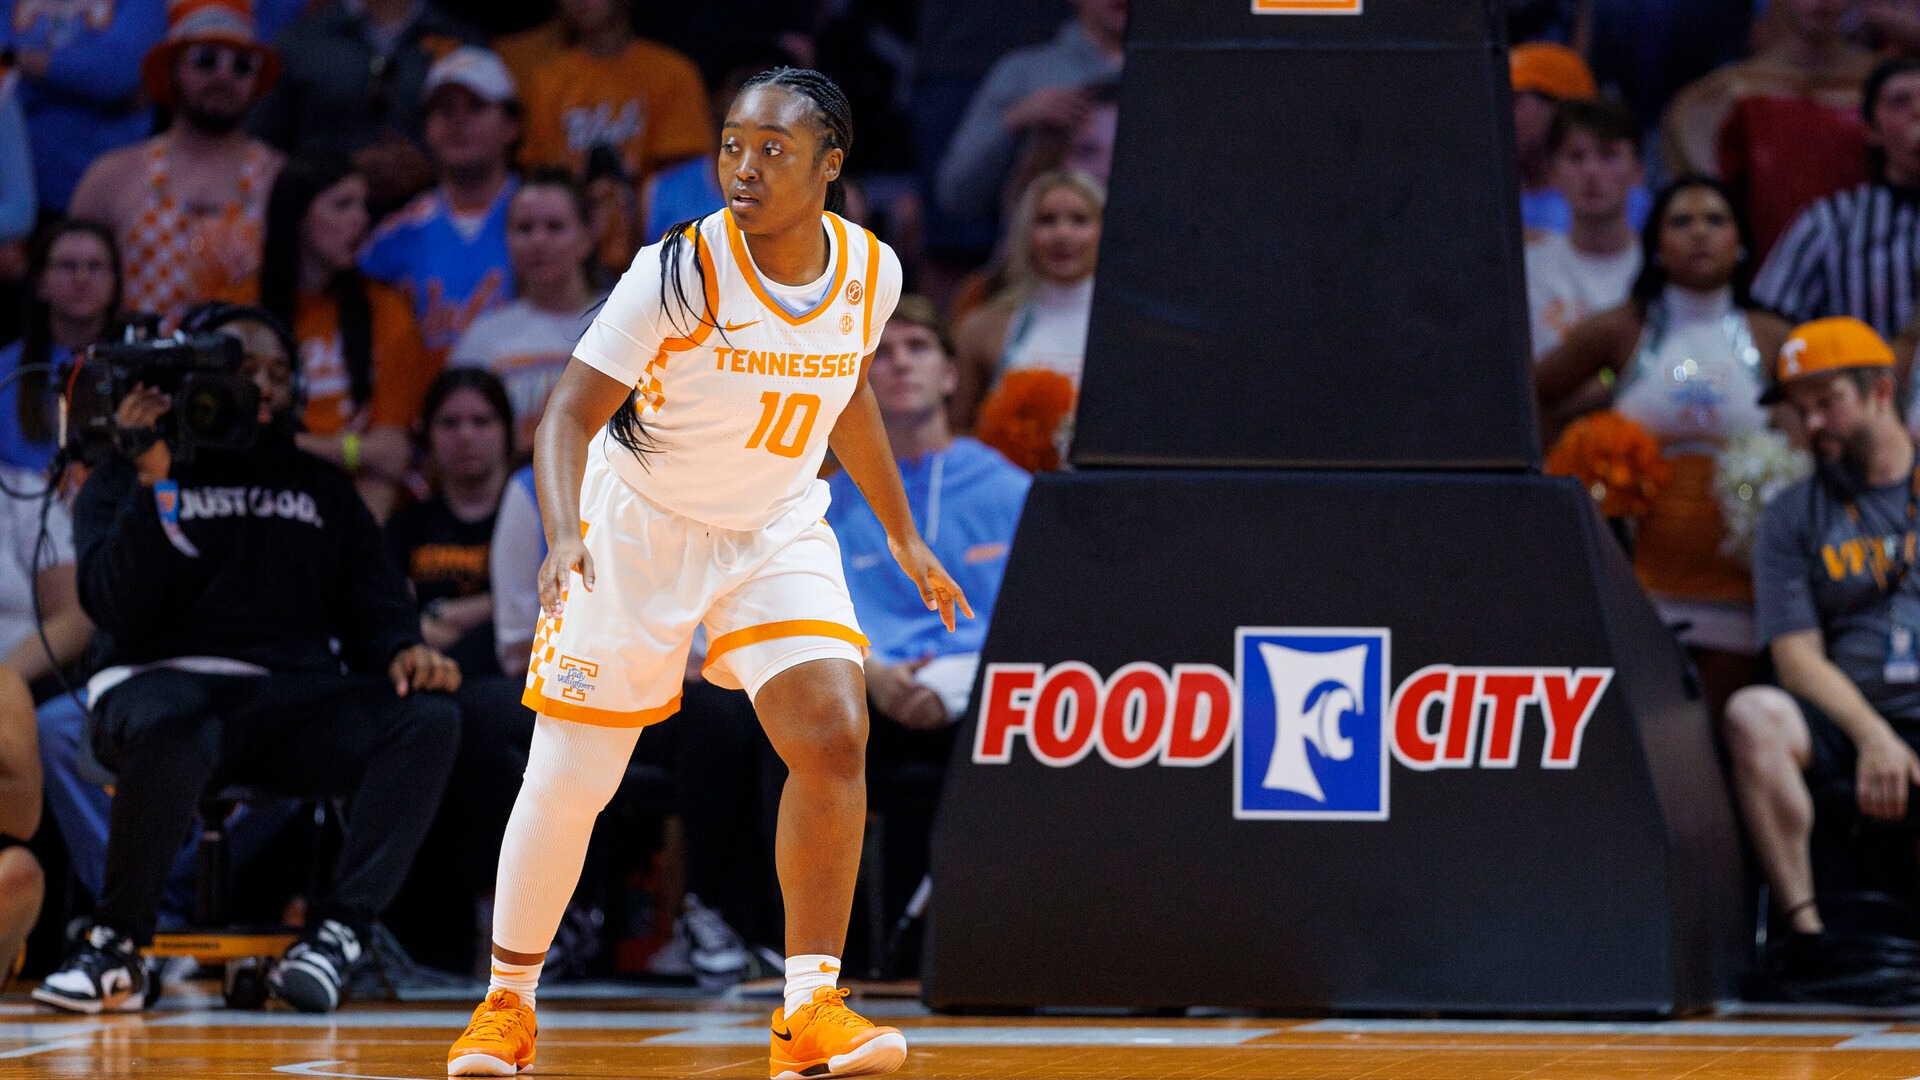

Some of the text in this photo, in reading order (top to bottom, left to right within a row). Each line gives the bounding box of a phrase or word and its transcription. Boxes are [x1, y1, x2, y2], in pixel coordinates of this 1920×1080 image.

[713, 346, 858, 379] TENNESSEE
[744, 390, 822, 459] 10
[972, 661, 1238, 768] FOOD
[1389, 664, 1614, 771] CITY
